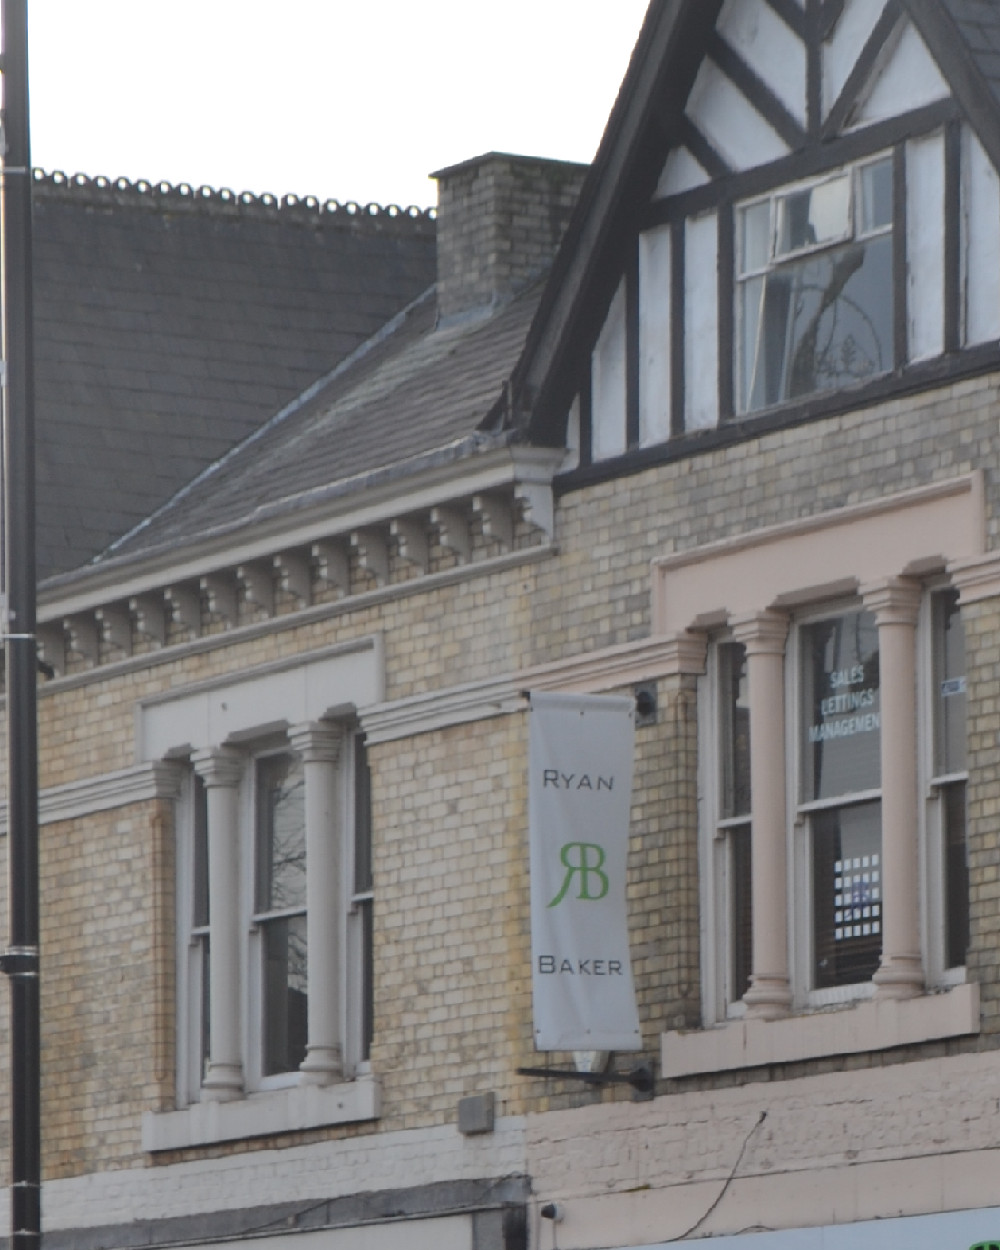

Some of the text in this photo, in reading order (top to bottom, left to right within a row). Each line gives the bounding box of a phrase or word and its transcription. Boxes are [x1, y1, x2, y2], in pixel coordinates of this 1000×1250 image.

[830, 665, 864, 688] SALES
[821, 688, 873, 715] LETTINGS
[808, 712, 881, 742] MANAGEMEN
[543, 769, 614, 790] RYAN
[538, 955, 623, 976] BAKER
